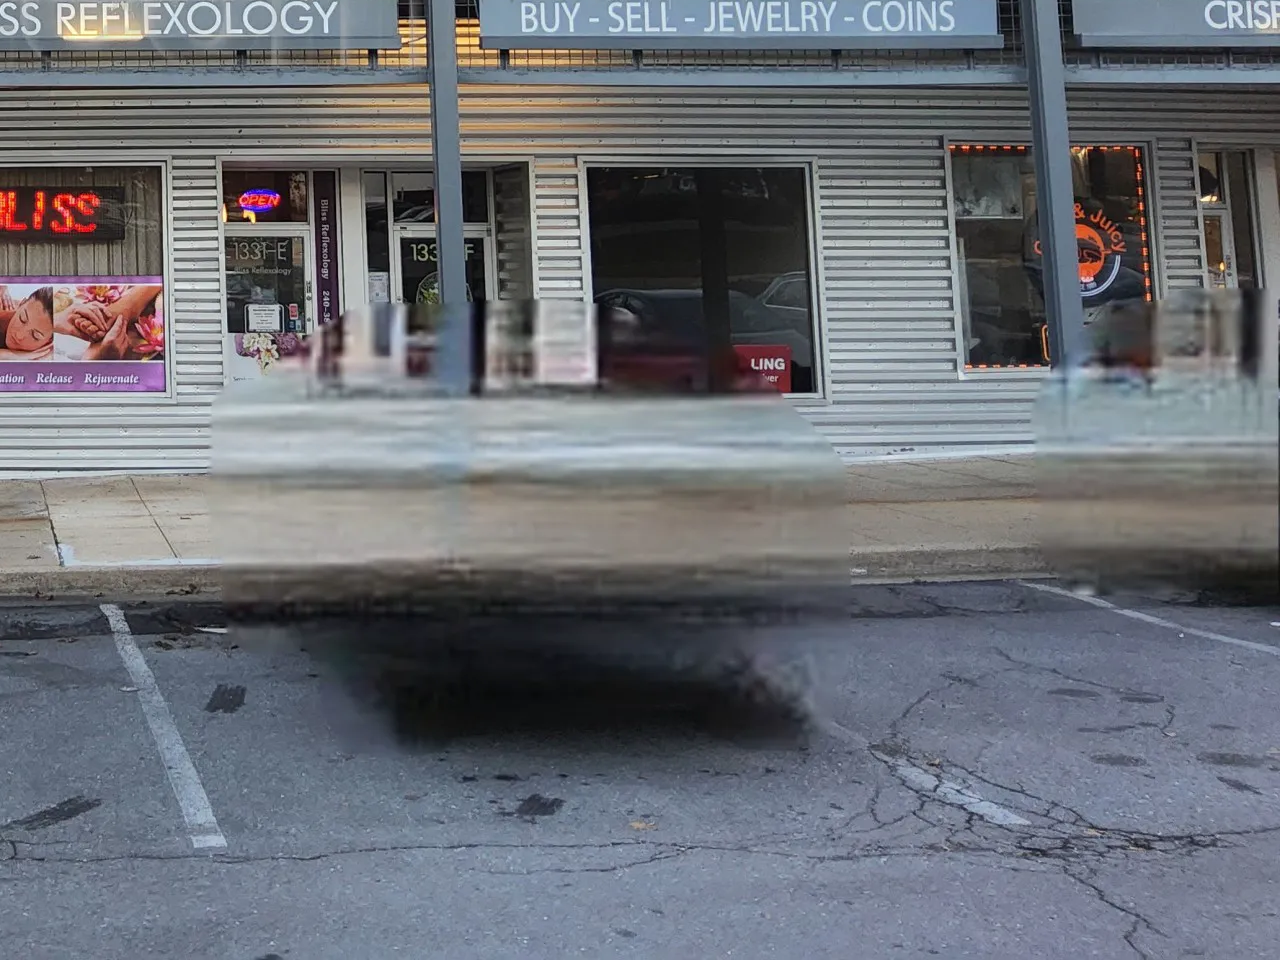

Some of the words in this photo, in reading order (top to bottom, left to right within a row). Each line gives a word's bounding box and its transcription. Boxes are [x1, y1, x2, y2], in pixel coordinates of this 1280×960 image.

[57, 0, 339, 36] REFLEXOLOGY
[520, 1, 582, 33] BUY
[608, 0, 677, 33] SELL
[703, 0, 838, 33] JEWELRY
[862, 0, 956, 33] COINS
[238, 194, 280, 207] OPEN
[320, 199, 328, 222] Bliss
[1090, 208, 1128, 253] Juicy
[320, 224, 331, 280] Reflexology
[252, 266, 292, 276] Reflexology
[36, 372, 73, 384] Release
[84, 372, 139, 386] Rejuvenate
